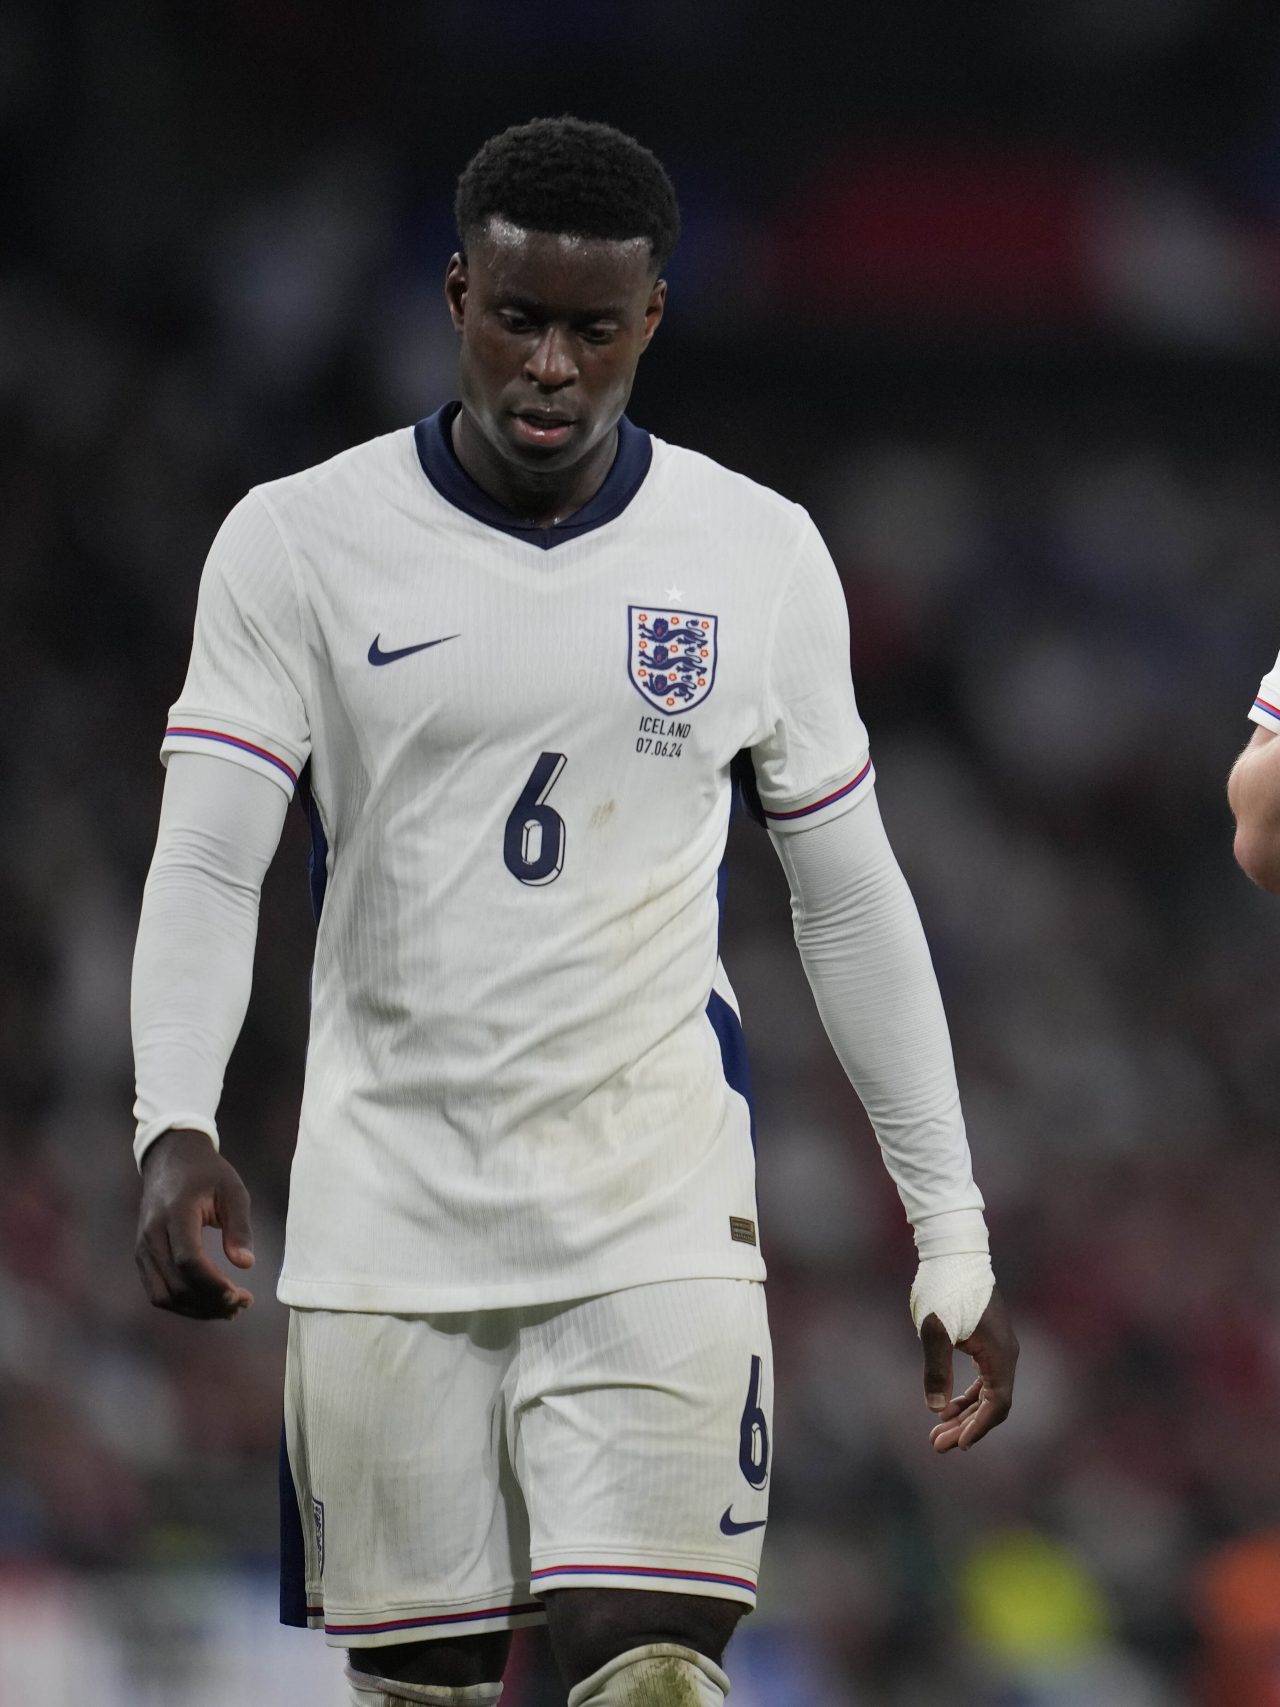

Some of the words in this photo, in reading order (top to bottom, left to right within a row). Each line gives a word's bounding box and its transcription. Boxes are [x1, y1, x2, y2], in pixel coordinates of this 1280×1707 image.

[635, 737, 683, 758] 07.06.24
[639, 715, 692, 739] ICELAND
[503, 751, 568, 887] 6
[739, 1354, 769, 1491] 6
